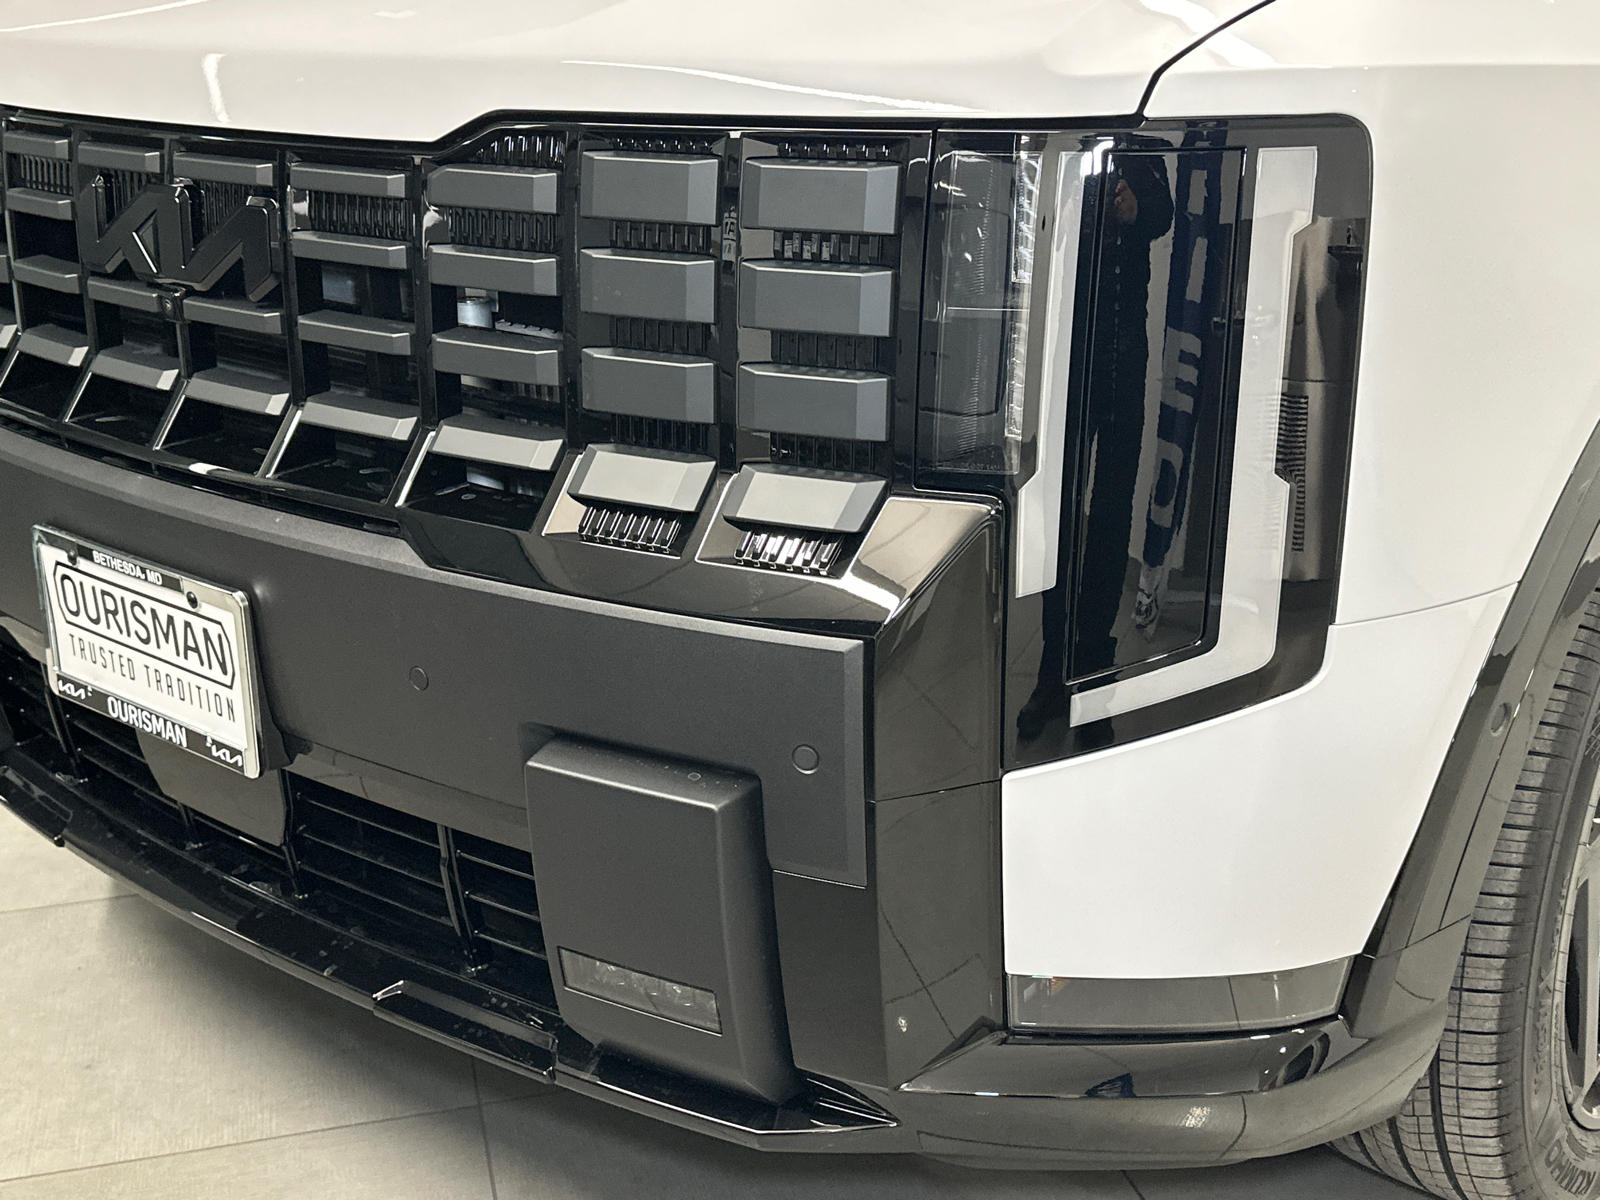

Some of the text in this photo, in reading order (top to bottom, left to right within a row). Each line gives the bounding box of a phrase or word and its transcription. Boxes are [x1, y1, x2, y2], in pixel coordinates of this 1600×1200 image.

[77, 174, 281, 301] KIA
[146, 568, 163, 586] MD
[60, 573, 229, 676] OURISMAN
[69, 633, 236, 723] TRUSTED TRADITION
[107, 696, 188, 748] OURISMAN
[1544, 1138, 1597, 1198] KUMHO
